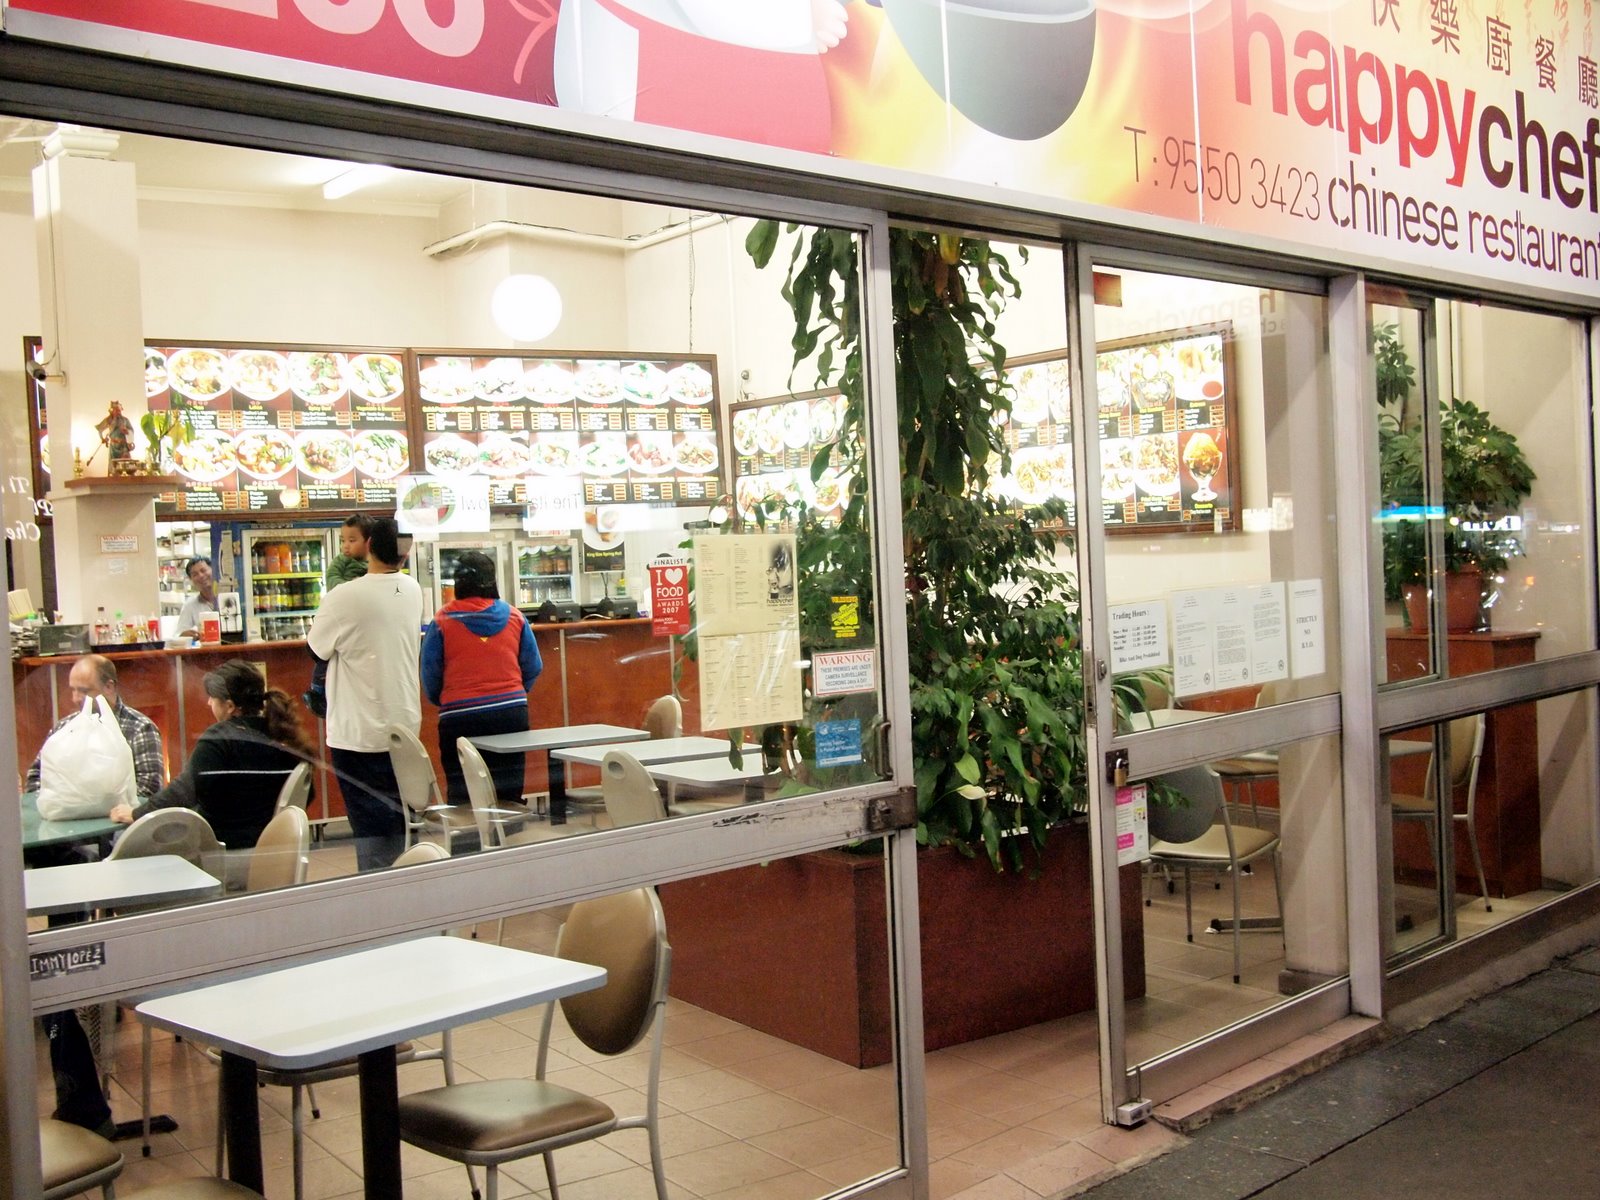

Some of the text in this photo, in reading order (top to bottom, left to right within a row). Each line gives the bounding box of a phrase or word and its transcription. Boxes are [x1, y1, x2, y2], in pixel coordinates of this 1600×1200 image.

[1250, 158, 1321, 221] 3423
[1327, 160, 1600, 281] chinese restauran
[656, 570, 663, 586] I
[656, 586, 684, 597] FOOD
[819, 653, 871, 665] WARNING
